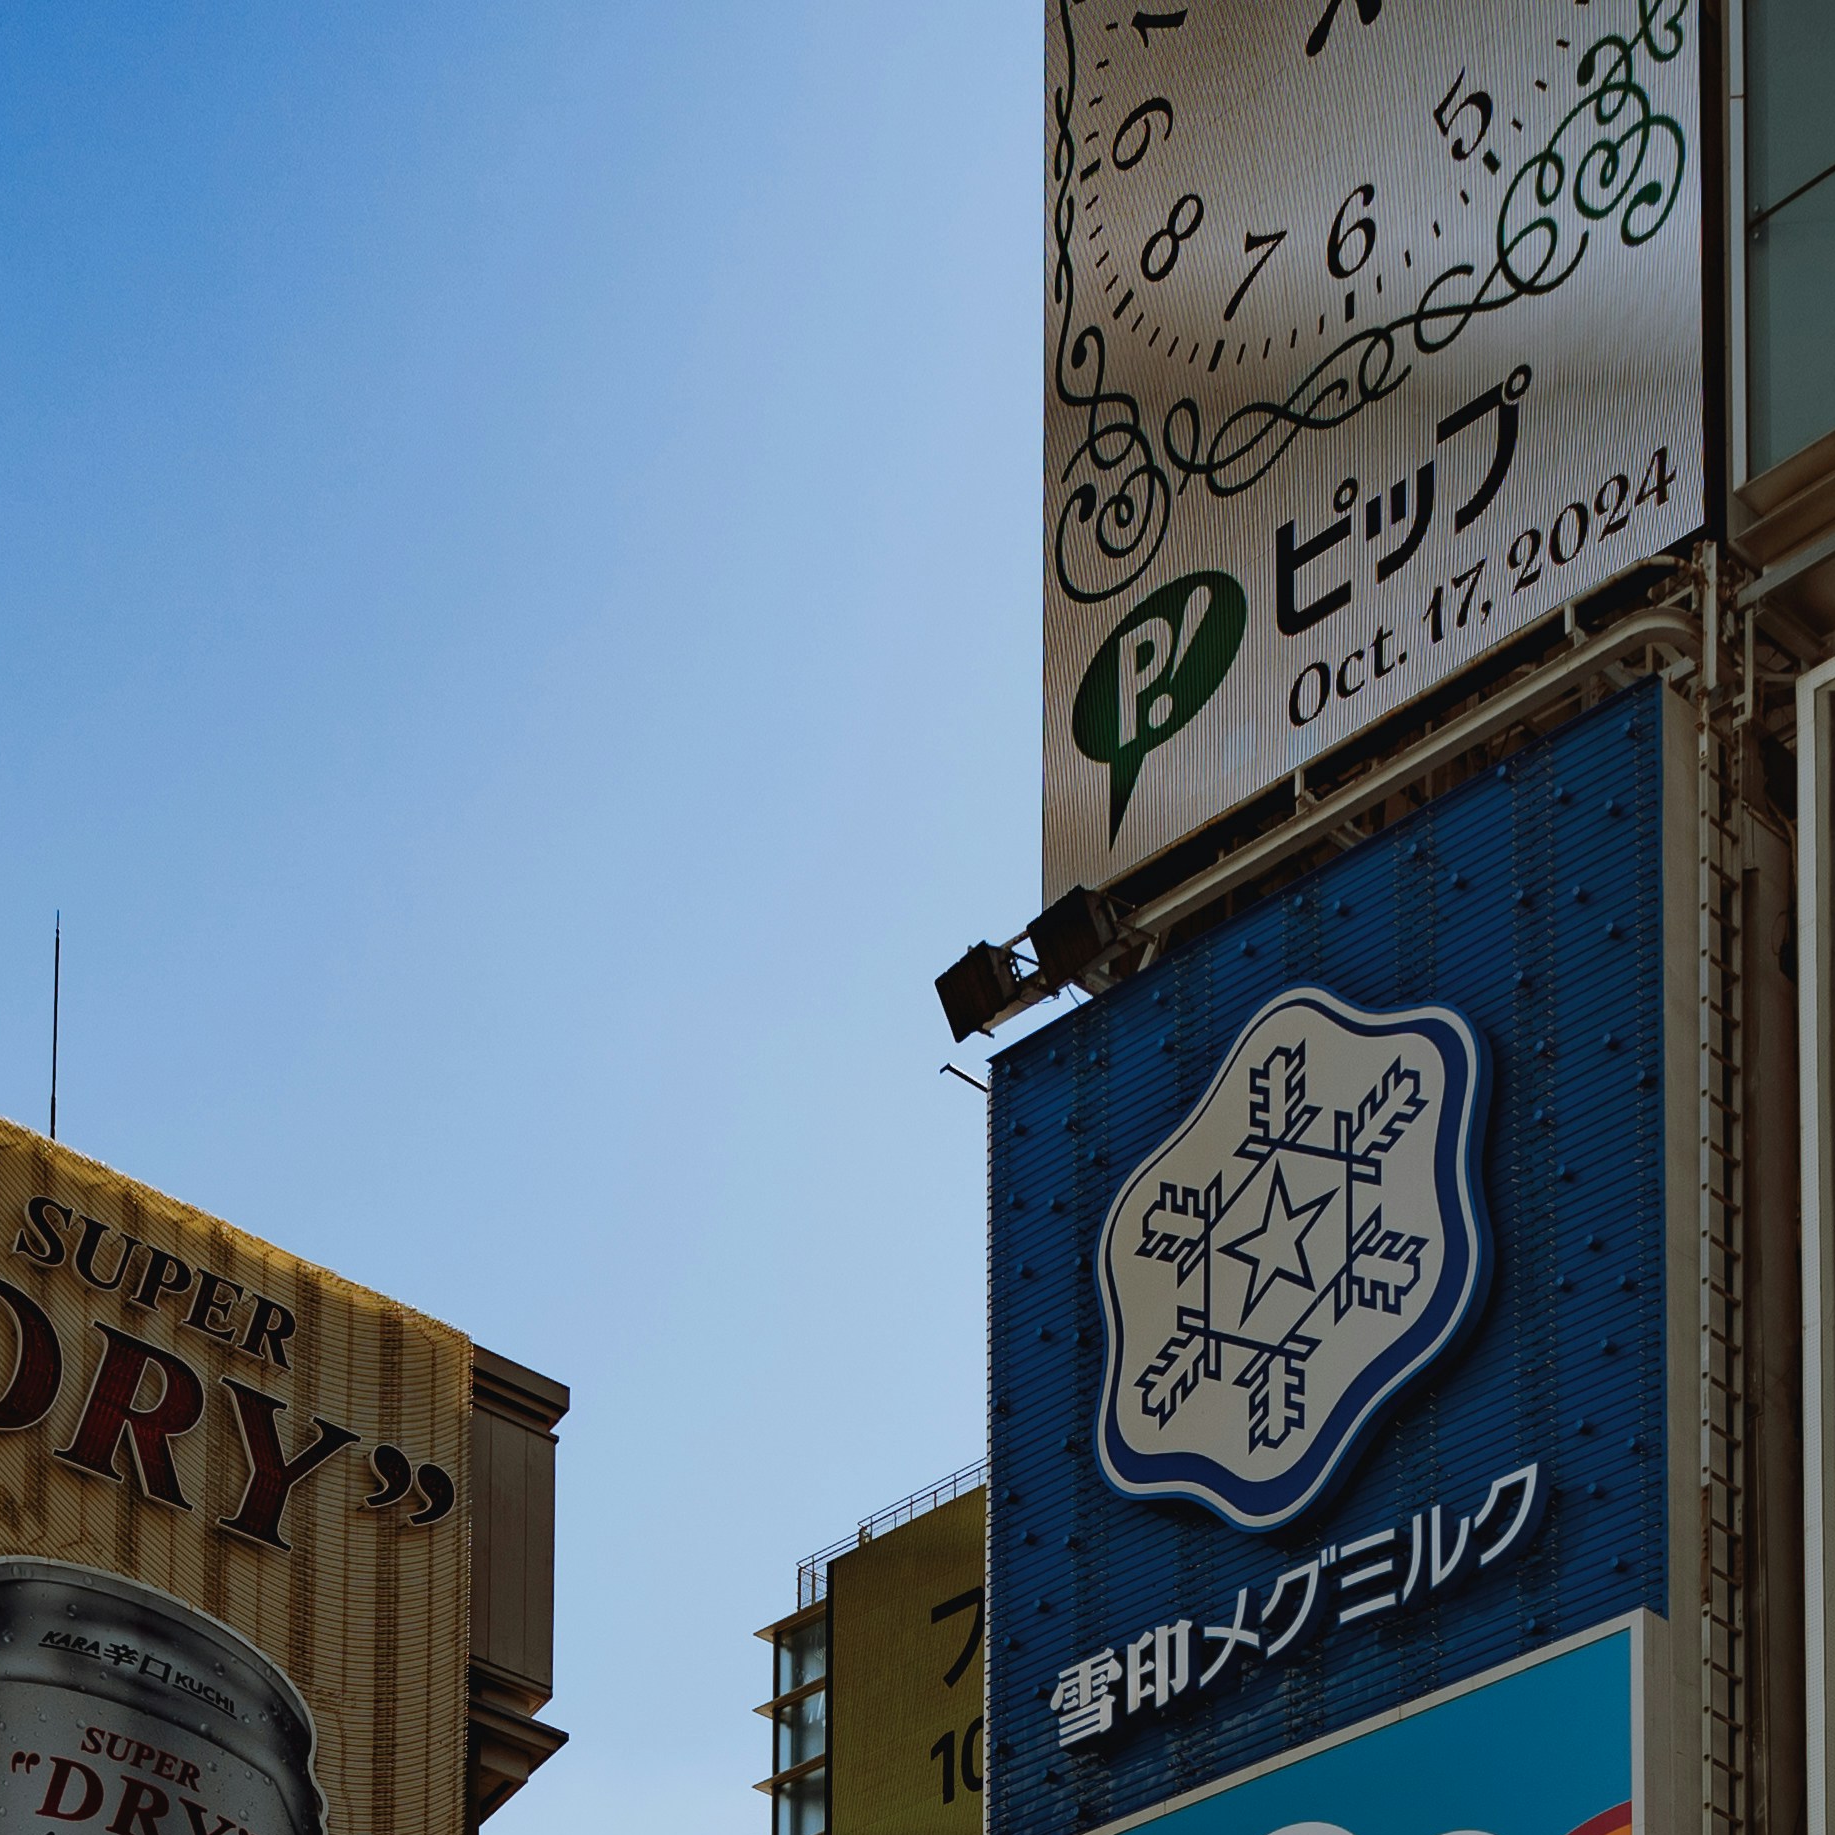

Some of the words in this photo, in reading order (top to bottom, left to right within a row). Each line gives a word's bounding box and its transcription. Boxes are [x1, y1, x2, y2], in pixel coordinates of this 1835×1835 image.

[1113, 98, 1173, 169] 9
[1433, 68, 1492, 159] 5
[1141, 194, 1204, 282] 8
[1225, 231, 1287, 321] 7
[1328, 185, 1376, 278] 6
[1274, 366, 1532, 636] ピップ
[1287, 647, 1408, 729] Oct.
[1423, 559, 1494, 643] 17,
[1508, 446, 1679, 594] 2024
[15, 1195, 297, 1371] SUPER
[1050, 1461, 1540, 1748] 雪印メグミルク
[42, 1631, 102, 1656] KARA
[103, 1643, 171, 1684] 辛口
[173, 1671, 236, 1713] KUCHI
[80, 1727, 200, 1793] SUPER
